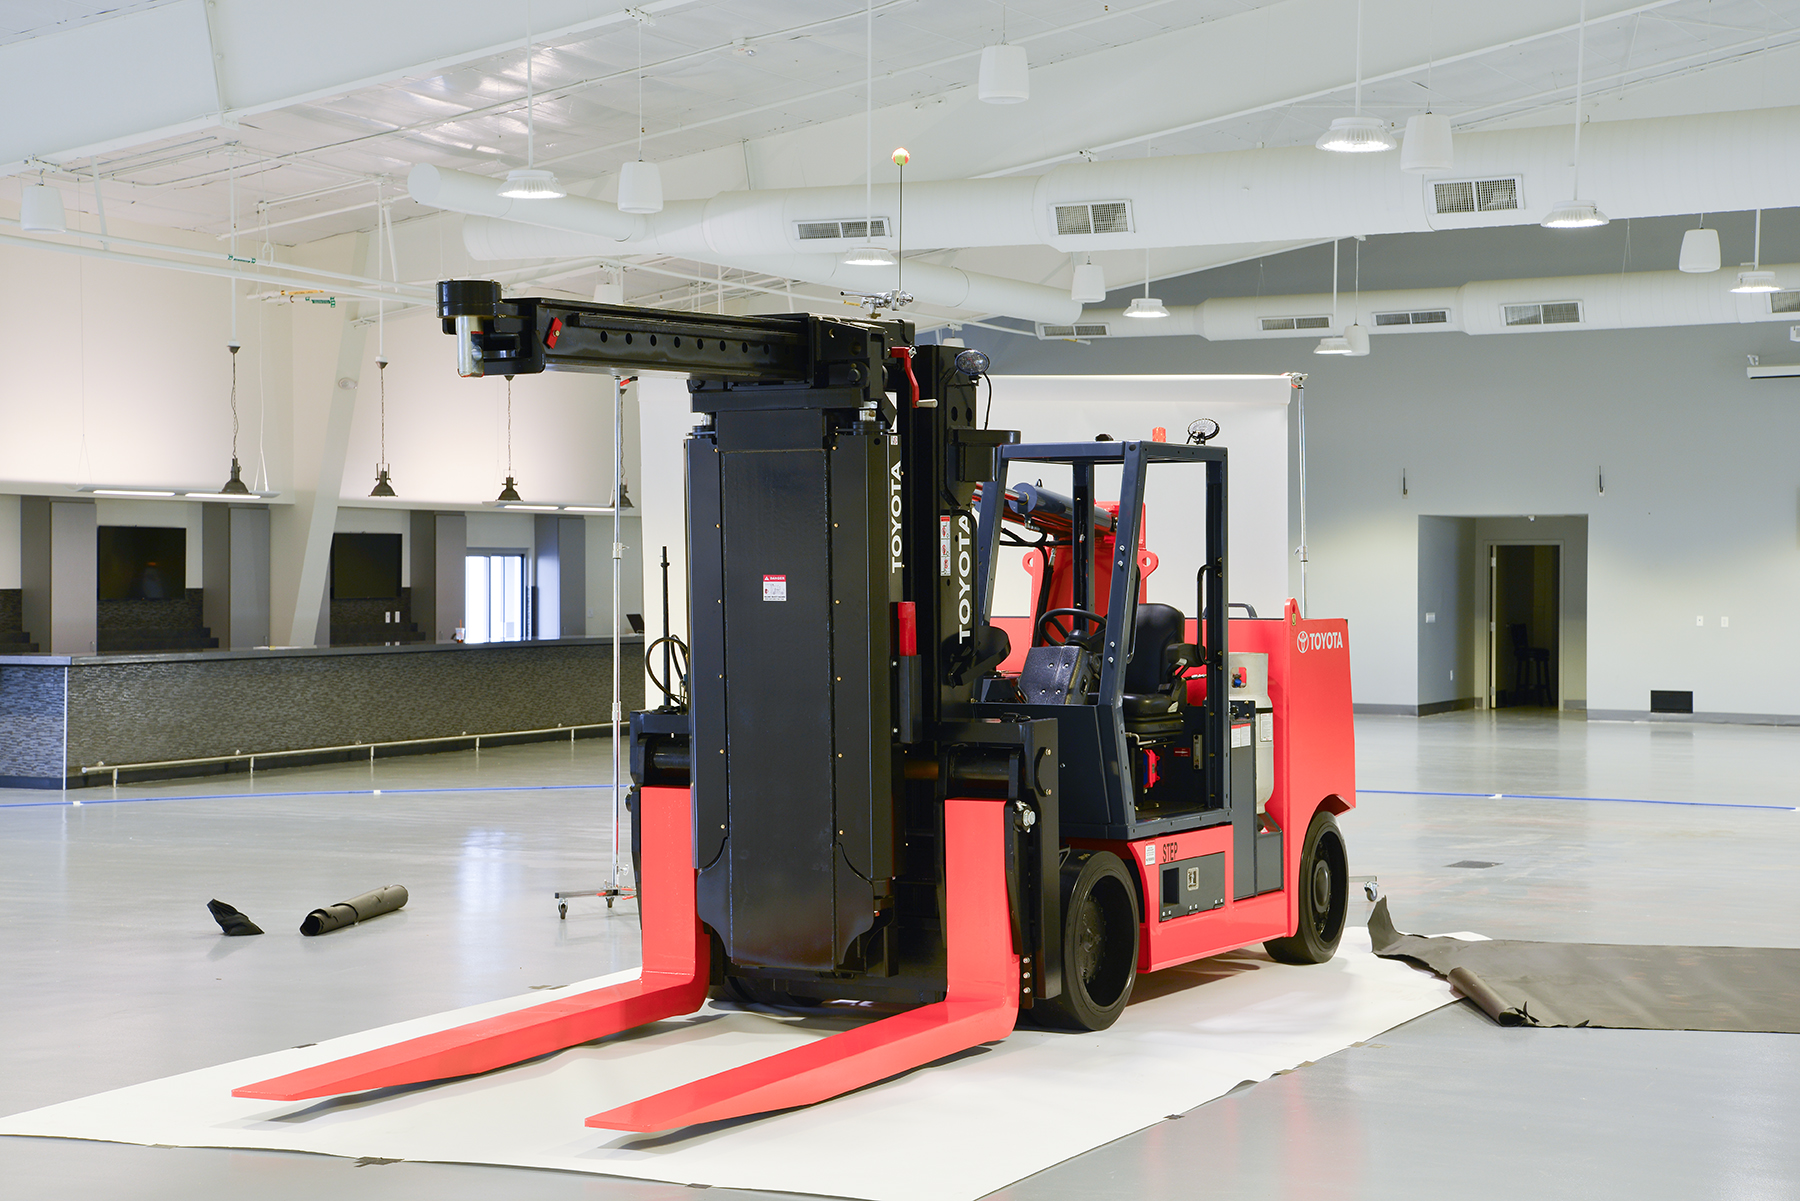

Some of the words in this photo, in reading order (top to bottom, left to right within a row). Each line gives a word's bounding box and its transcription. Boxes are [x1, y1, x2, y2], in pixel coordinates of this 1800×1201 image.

[890, 461, 902, 573] TOYOTA
[958, 515, 971, 644] TOYOTA
[1310, 632, 1343, 650] TOYOTA
[1163, 842, 1178, 862] STEP
